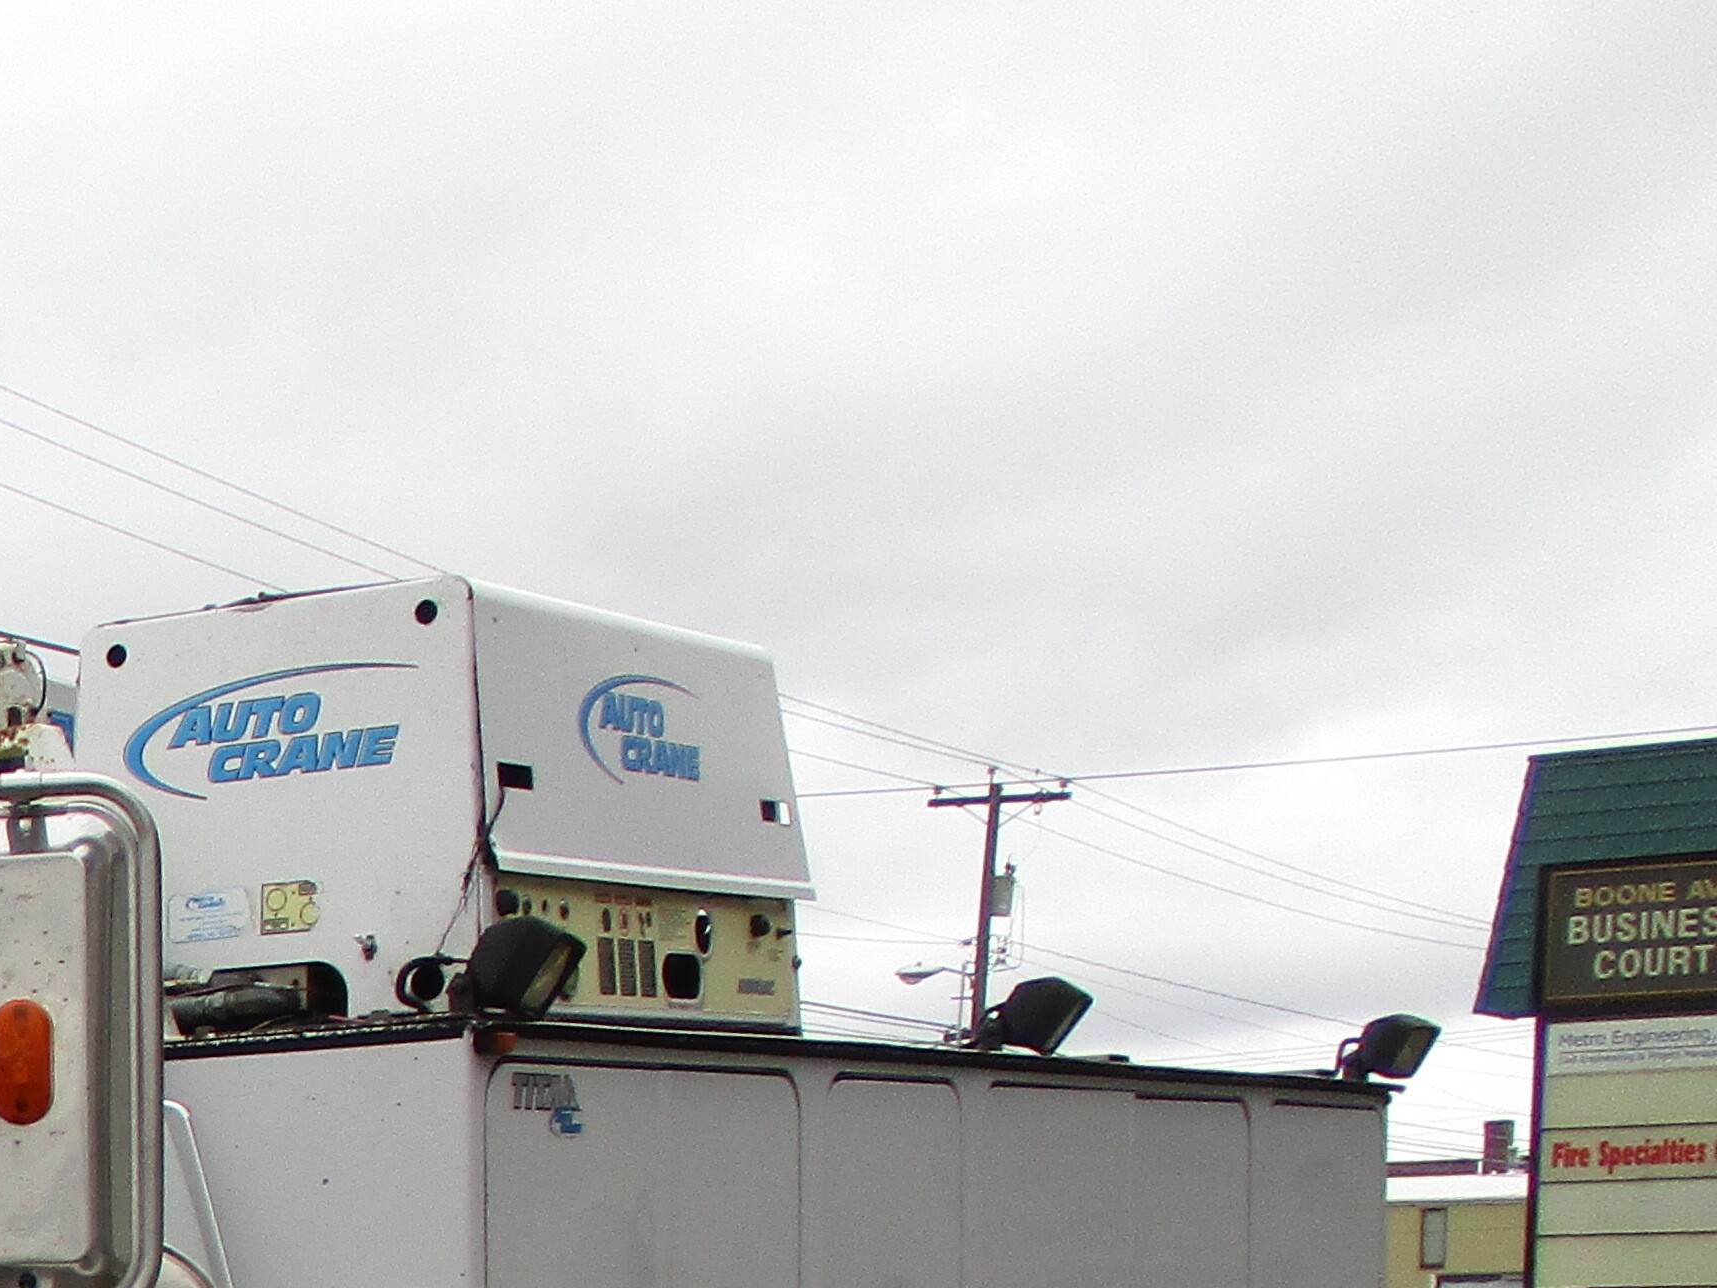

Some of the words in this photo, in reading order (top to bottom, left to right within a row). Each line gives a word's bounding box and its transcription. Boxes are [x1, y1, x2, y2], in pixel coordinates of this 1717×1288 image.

[167, 691, 323, 750] AUTO
[599, 691, 665, 739] AUTO
[208, 724, 400, 784] CRANE
[621, 735, 701, 782] CRANE
[1574, 881, 1677, 909] BOONE
[1593, 944, 1716, 979] COURT
[1559, 1034, 1607, 1047] Metro
[1551, 1141, 1591, 1168] Fire
[1598, 1137, 1707, 1175] Specialties
